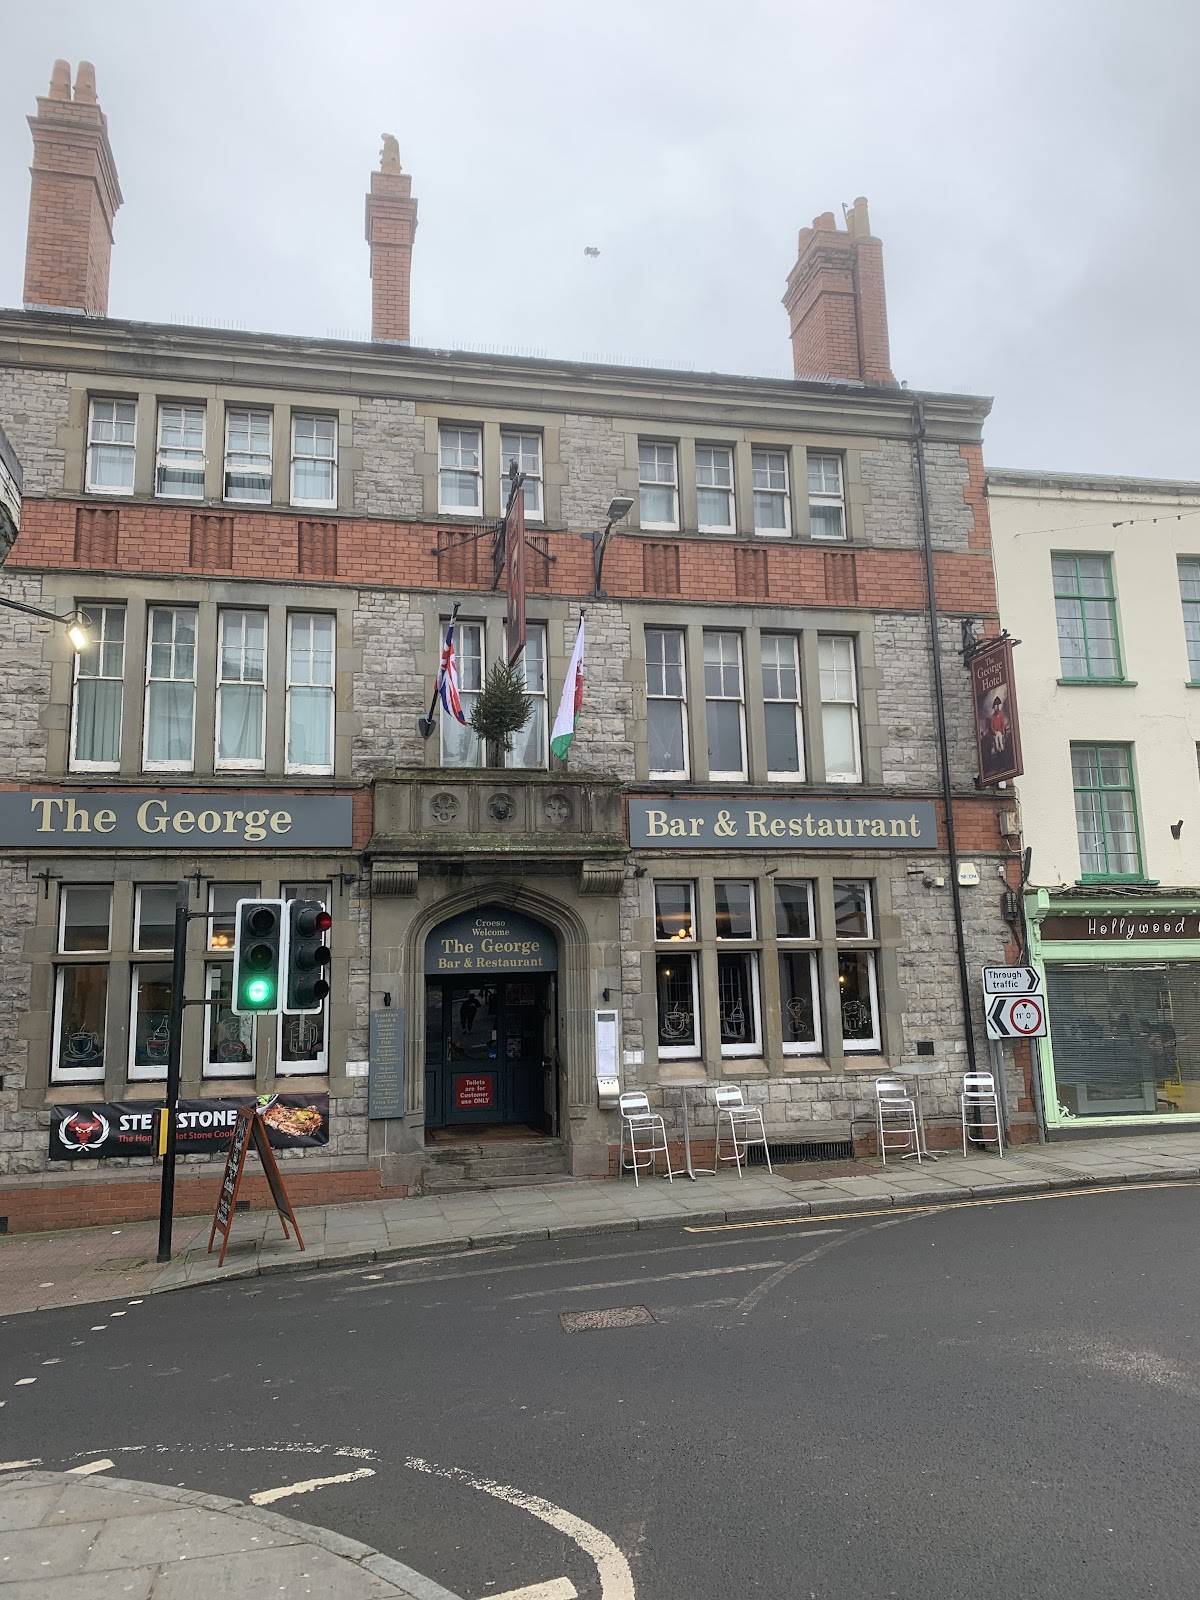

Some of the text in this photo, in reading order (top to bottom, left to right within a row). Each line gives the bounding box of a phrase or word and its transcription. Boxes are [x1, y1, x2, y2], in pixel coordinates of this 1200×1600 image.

[985, 656, 995, 666] The
[977, 660, 1003, 679] George
[981, 671, 1002, 691] Hotel
[31, 798, 292, 842] The George
[645, 809, 921, 839] Bar & Restaurant
[475, 919, 506, 927] Croeso
[1088, 917, 1185, 939] Hollywood
[472, 928, 510, 937] Welcome
[441, 938, 540, 955] The George
[438, 957, 543, 969] Bar & Restaurant
[988, 970, 1022, 980] Through
[993, 979, 1019, 988] traffic
[119, 1110, 238, 1131] STESTONE
[118, 1134, 134, 1143] The
[188, 1131, 213, 1140] Stone
[213, 1129, 237, 1138] Cook
